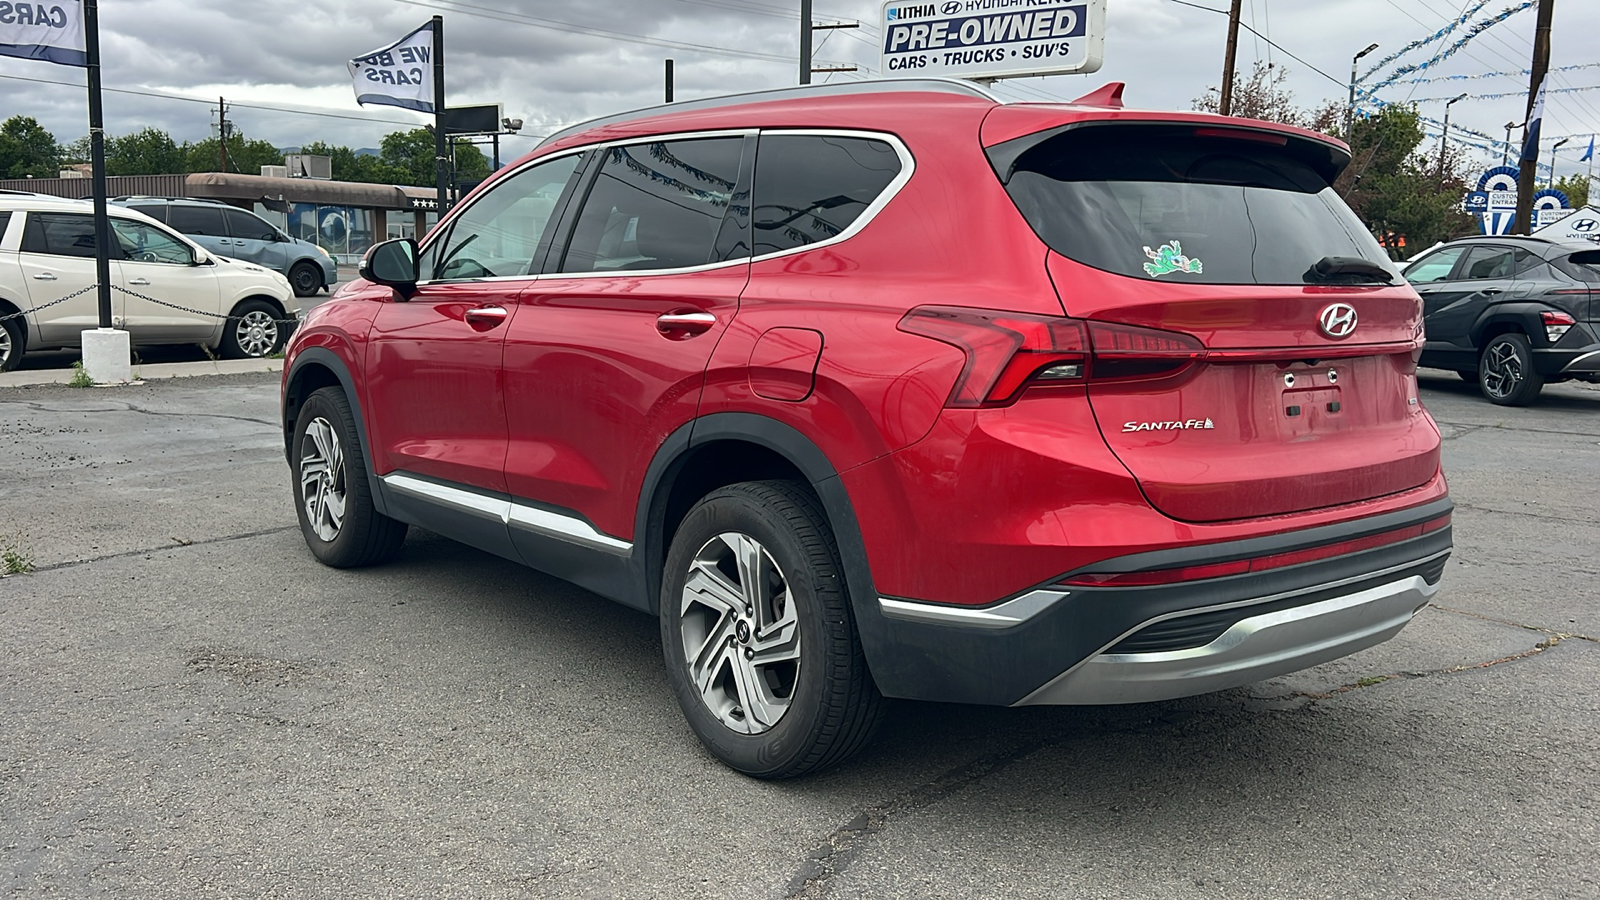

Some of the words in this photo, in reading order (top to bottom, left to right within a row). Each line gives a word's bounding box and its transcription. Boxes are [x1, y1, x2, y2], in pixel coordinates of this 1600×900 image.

[897, 4, 936, 19] LITHIA
[889, 9, 1078, 51] PRE-OWNED
[888, 55, 927, 70] CARS
[943, 47, 1005, 66] TRUCKS
[1021, 42, 1070, 59] SUV'S
